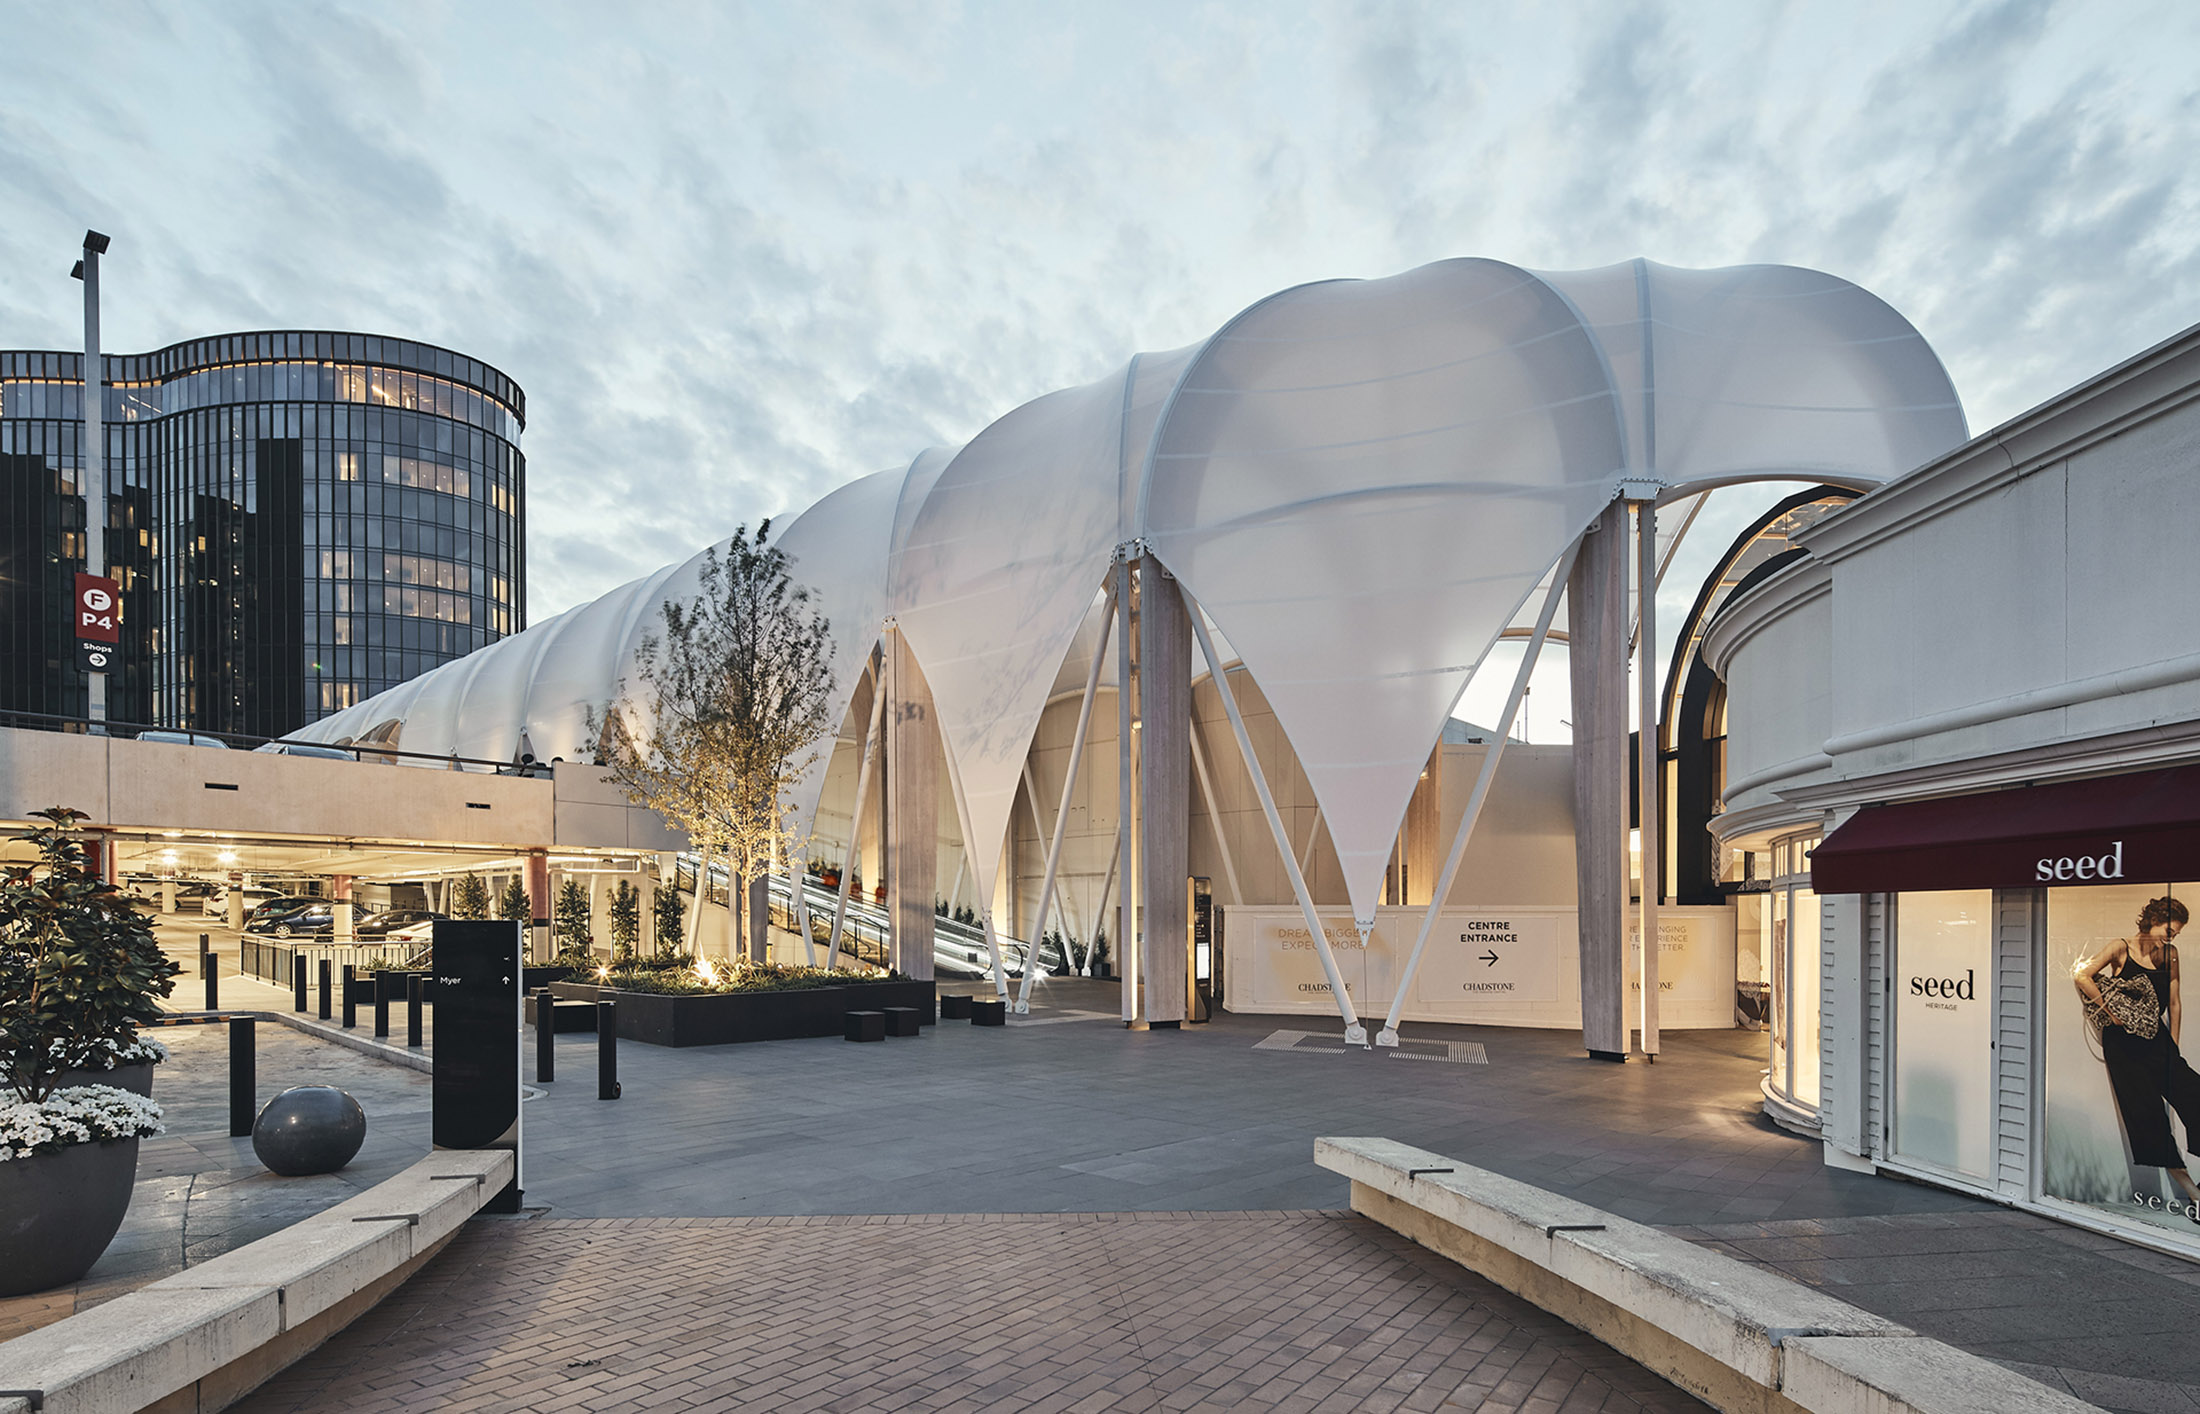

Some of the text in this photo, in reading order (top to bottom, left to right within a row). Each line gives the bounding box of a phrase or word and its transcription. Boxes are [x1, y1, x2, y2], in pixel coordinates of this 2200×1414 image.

[91, 592, 104, 606] F
[82, 612, 112, 630] P4
[83, 642, 112, 654] Shops
[2035, 840, 2125, 882] seed
[1468, 921, 1510, 930] CENTRE
[1278, 928, 1311, 938] DREA
[1460, 934, 1518, 943] ENTRANCE
[440, 976, 461, 986] Myer
[1462, 982, 1515, 991] CHADSTONE
[1910, 968, 1976, 1001] seed
[1925, 1002, 1958, 1011] HERITAGE
[2132, 1191, 2200, 1221] seed
